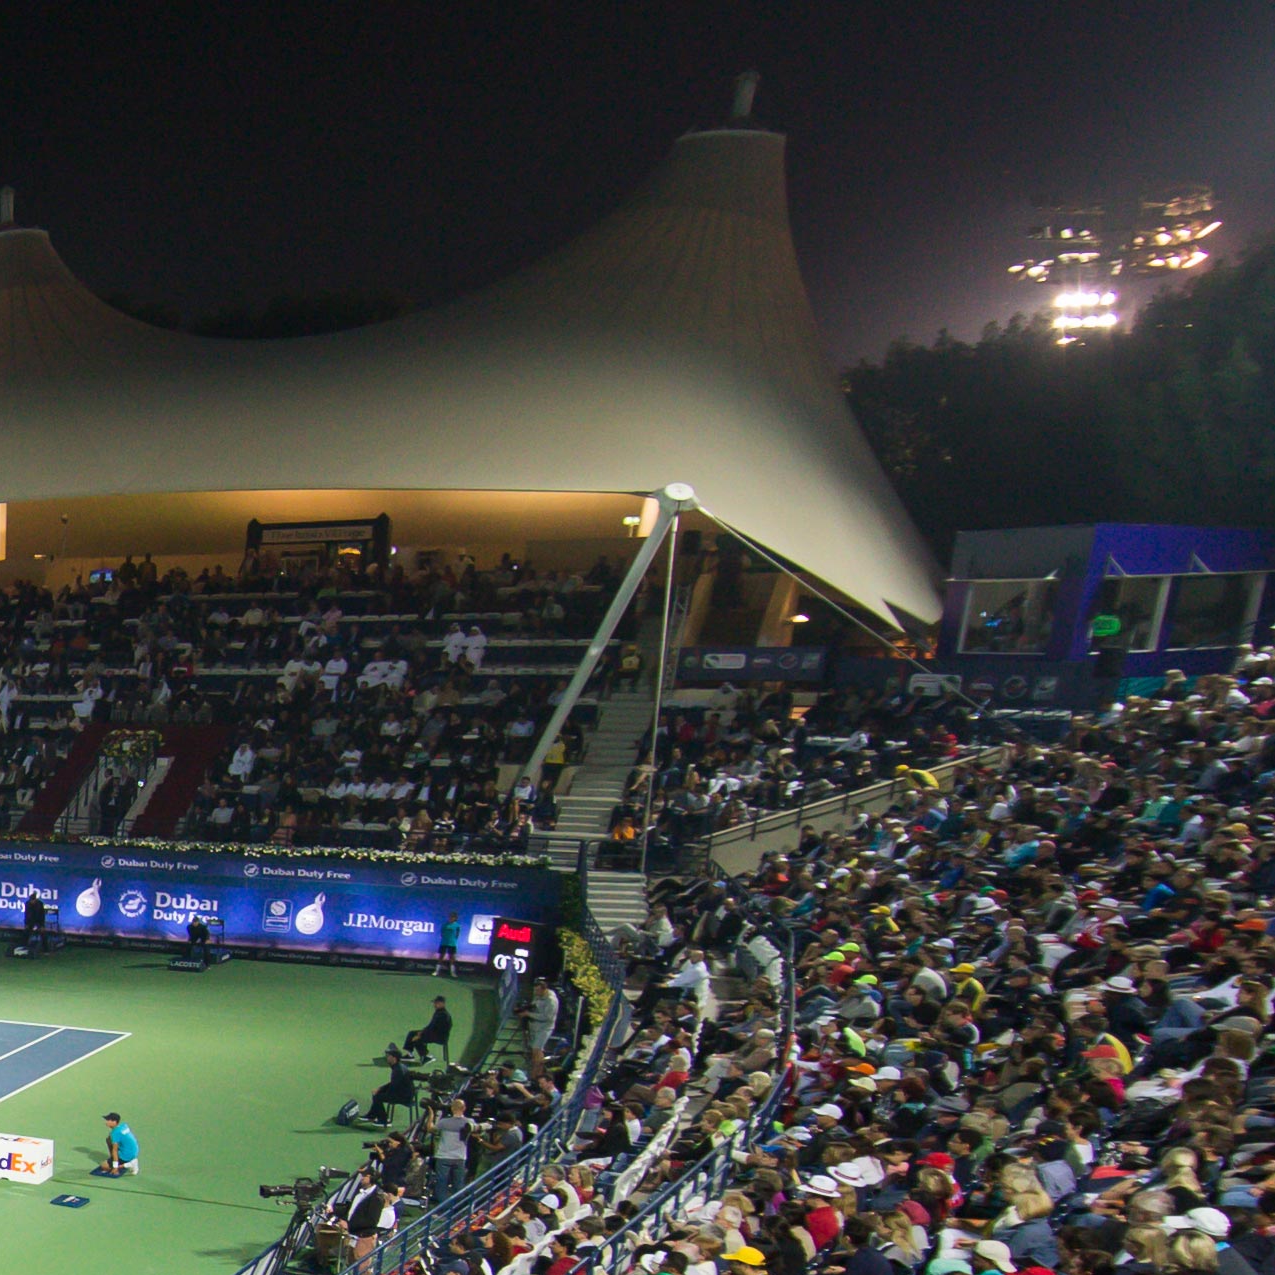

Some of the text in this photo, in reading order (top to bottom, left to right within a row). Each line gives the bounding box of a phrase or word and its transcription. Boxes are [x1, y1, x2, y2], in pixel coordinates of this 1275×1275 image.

[14, 853, 36, 863] Duty
[39, 855, 59, 863] Free
[118, 858, 199, 871] Dubai Duty Free
[262, 867, 351, 880] Dubai Duty Free
[421, 875, 518, 889] Dubai Duty Free
[1, 882, 58, 901] Dubai
[0, 898, 26, 913] Duty
[155, 892, 218, 911] Dubai
[153, 909, 186, 924] Duty
[343, 912, 435, 936] J.P.Morgan
[497, 923, 531, 942] Audi
